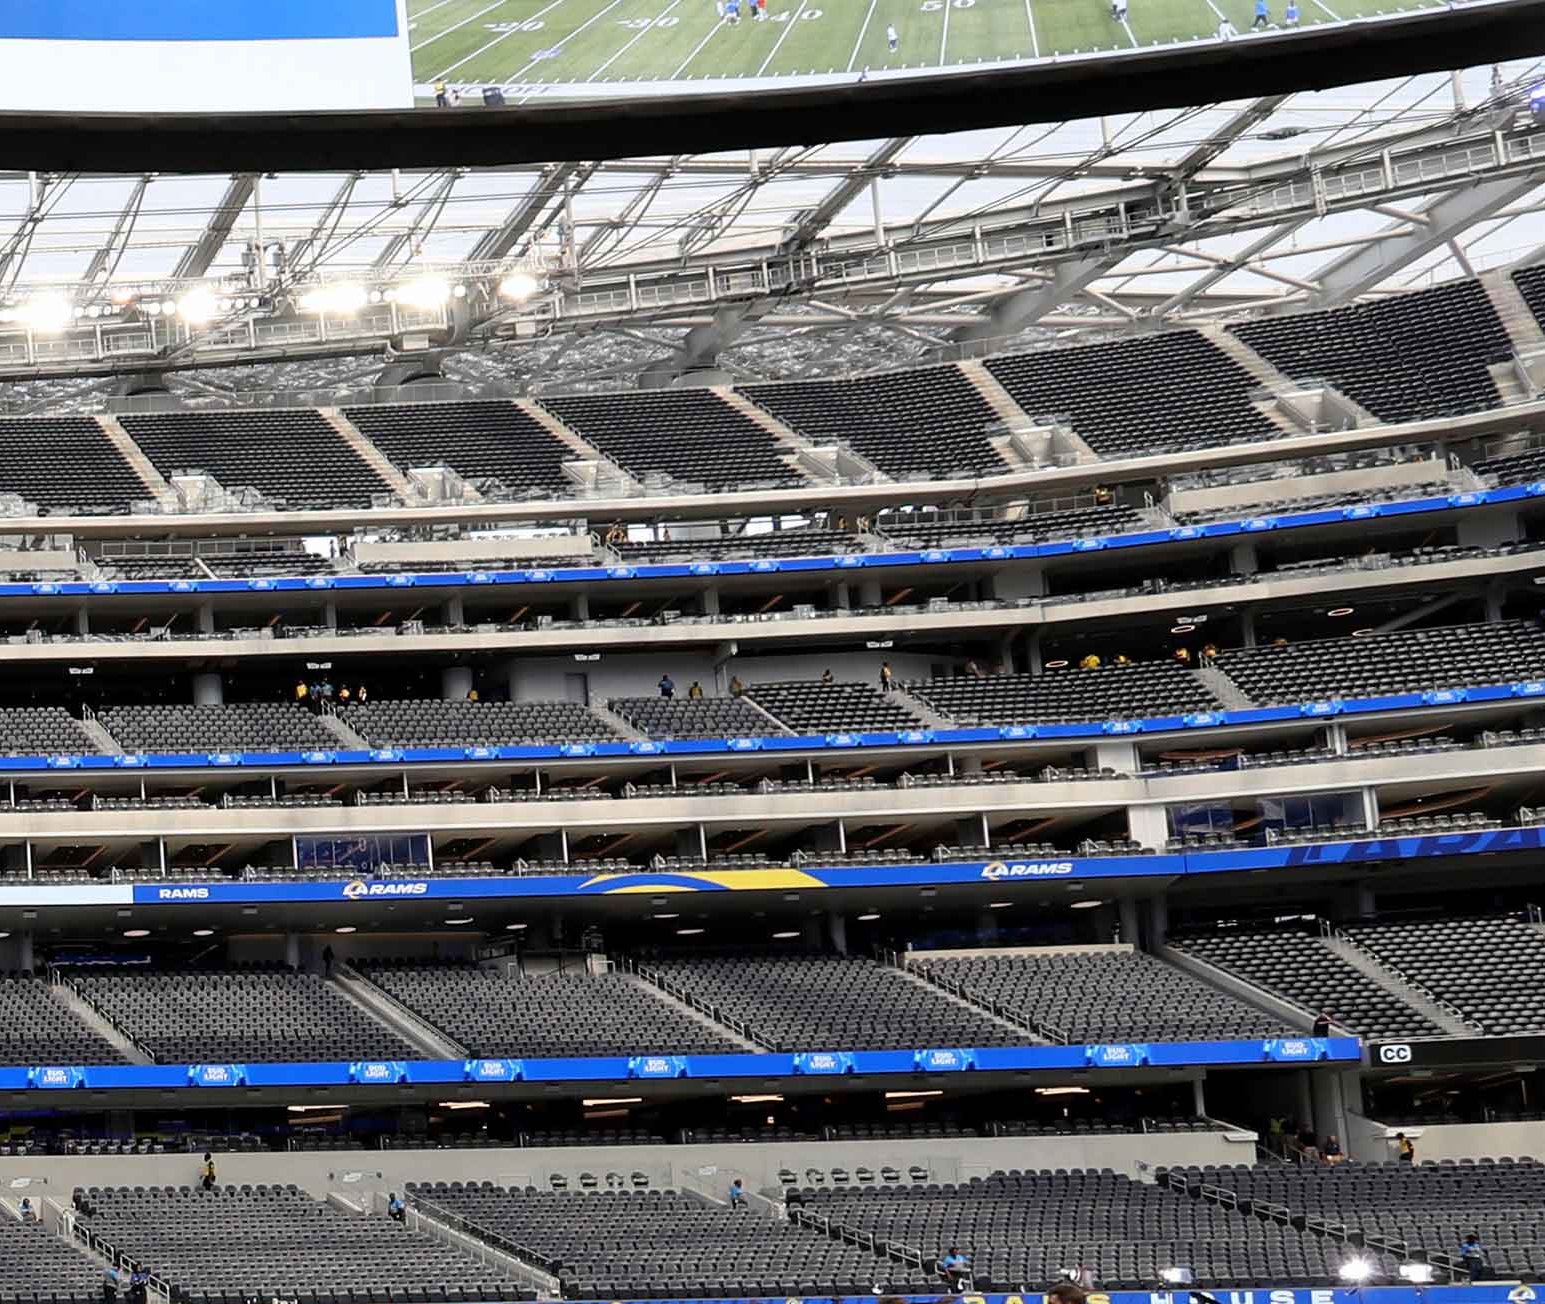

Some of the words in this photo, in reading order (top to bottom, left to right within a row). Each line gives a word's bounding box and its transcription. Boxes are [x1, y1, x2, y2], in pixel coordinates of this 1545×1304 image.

[1011, 862, 1073, 877] RAMS
[159, 888, 209, 899] RAMS
[370, 883, 427, 895] RAMS
[1384, 1048, 1409, 1060] CC
